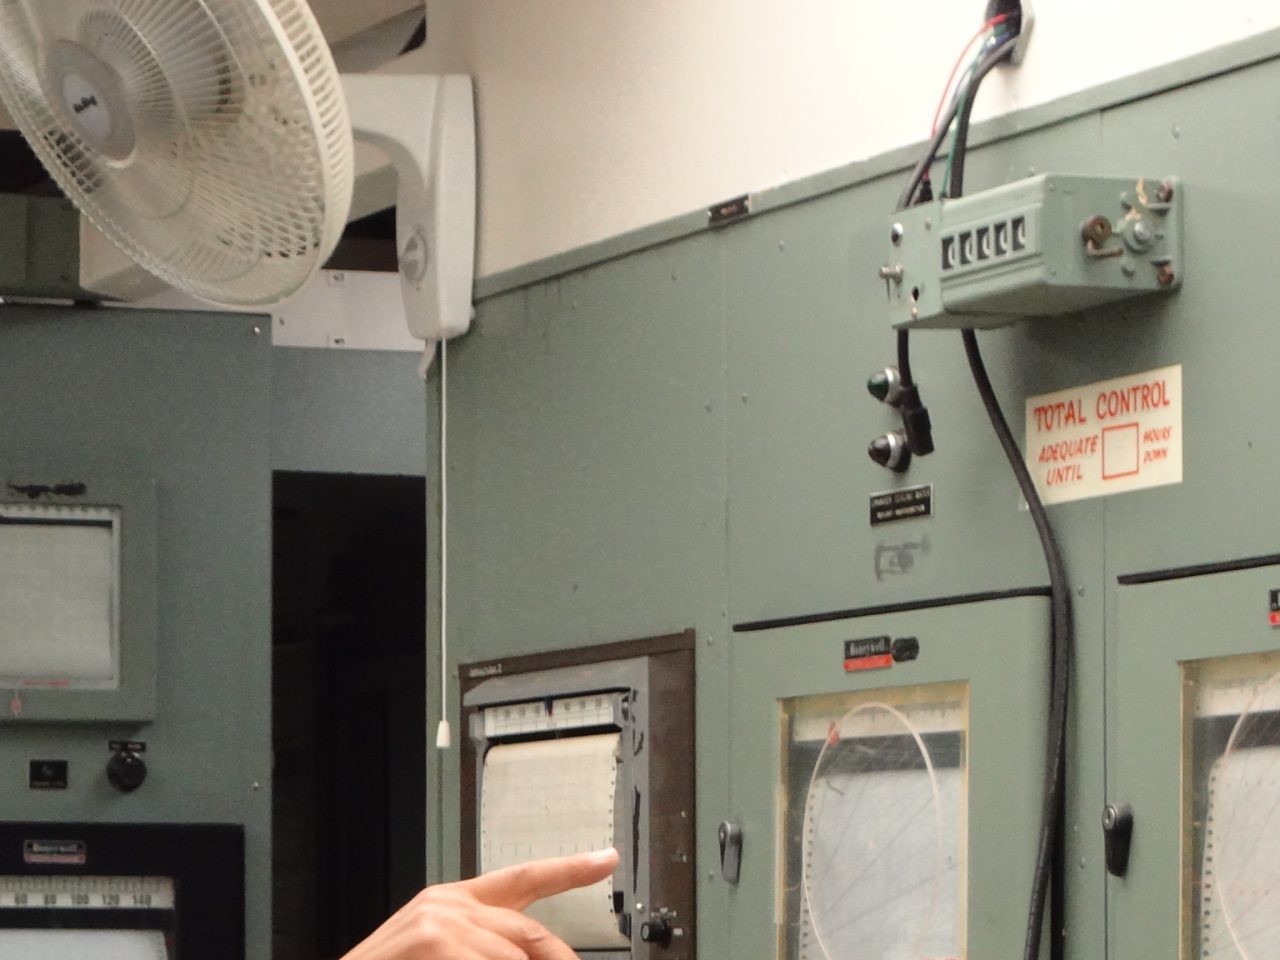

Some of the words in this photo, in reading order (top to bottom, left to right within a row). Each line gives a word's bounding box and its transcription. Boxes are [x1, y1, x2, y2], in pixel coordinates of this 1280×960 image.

[1034, 399, 1087, 432] TOTAL
[1096, 380, 1170, 420] CONTROL
[1038, 435, 1098, 463] ADEQUATE
[1046, 464, 1083, 486] UNTIL
[71, 894, 90, 906] 100
[102, 894, 120, 906] 120
[132, 894, 152, 906] 140
